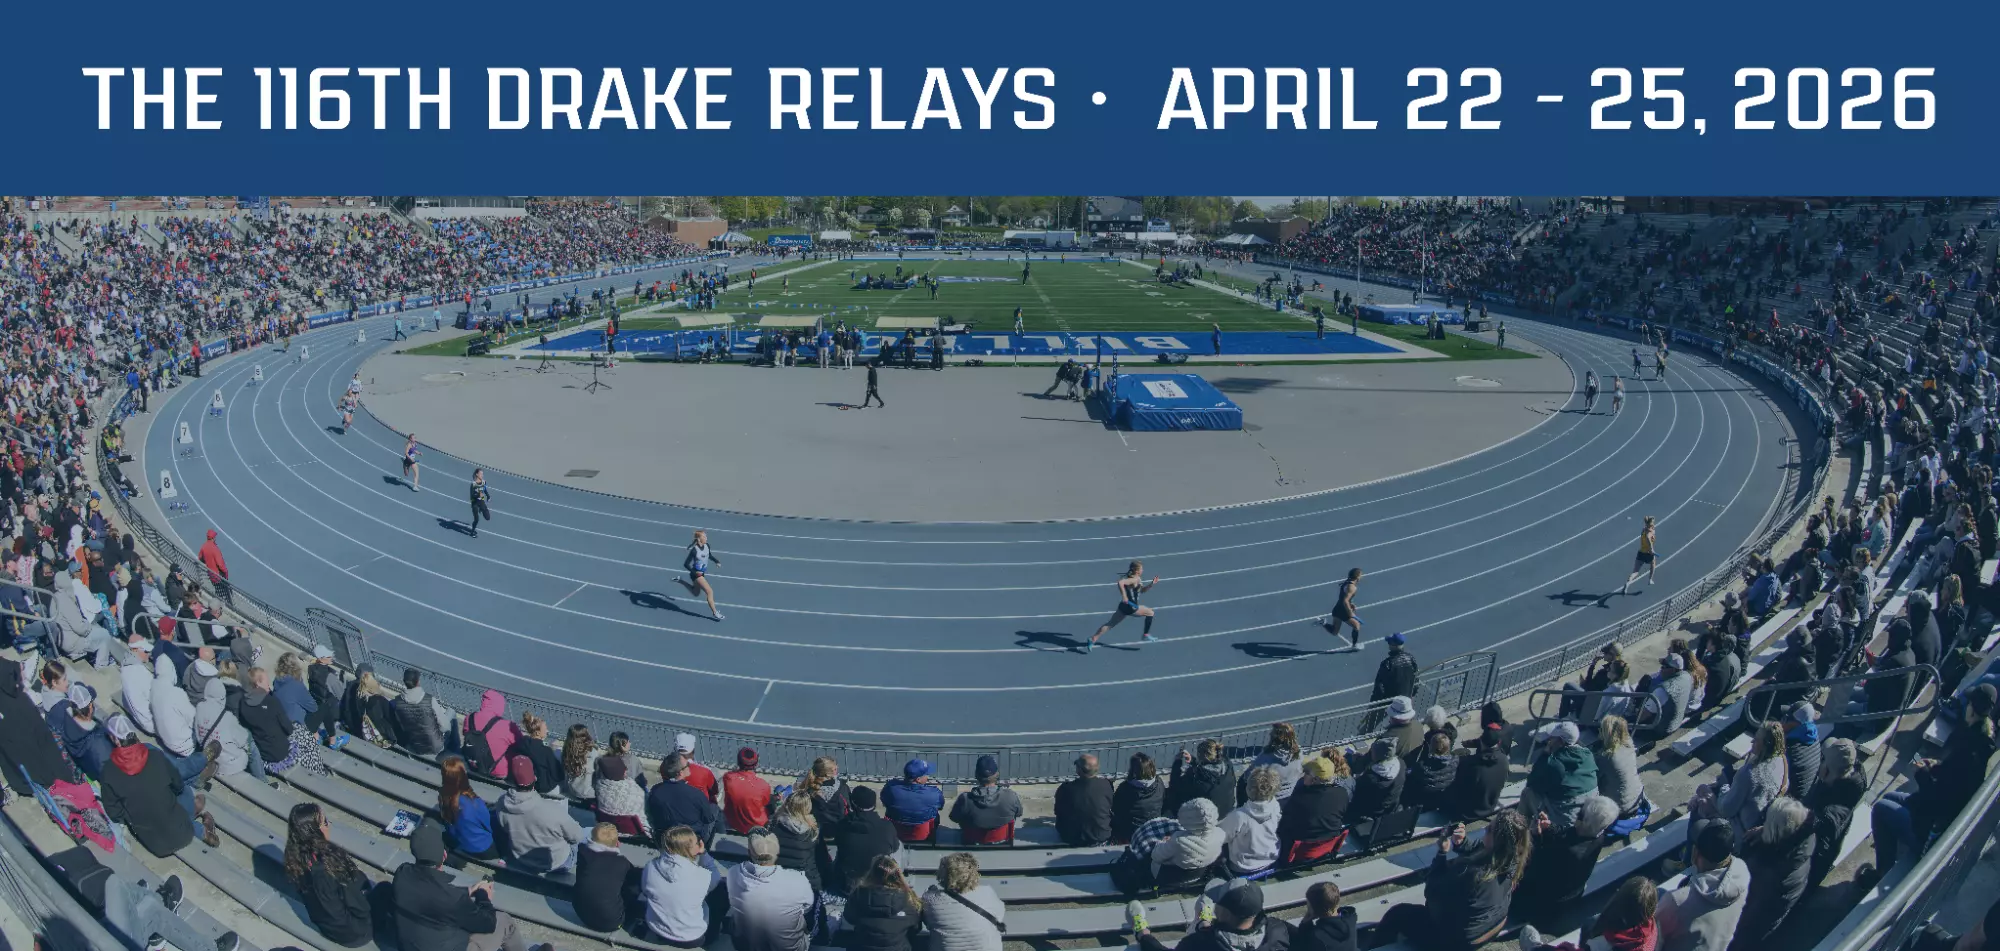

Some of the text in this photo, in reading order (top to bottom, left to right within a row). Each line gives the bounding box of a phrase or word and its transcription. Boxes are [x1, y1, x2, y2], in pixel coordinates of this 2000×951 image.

[215, 394, 221, 402] 6
[181, 427, 187, 437] 7
[163, 477, 170, 489] 8
